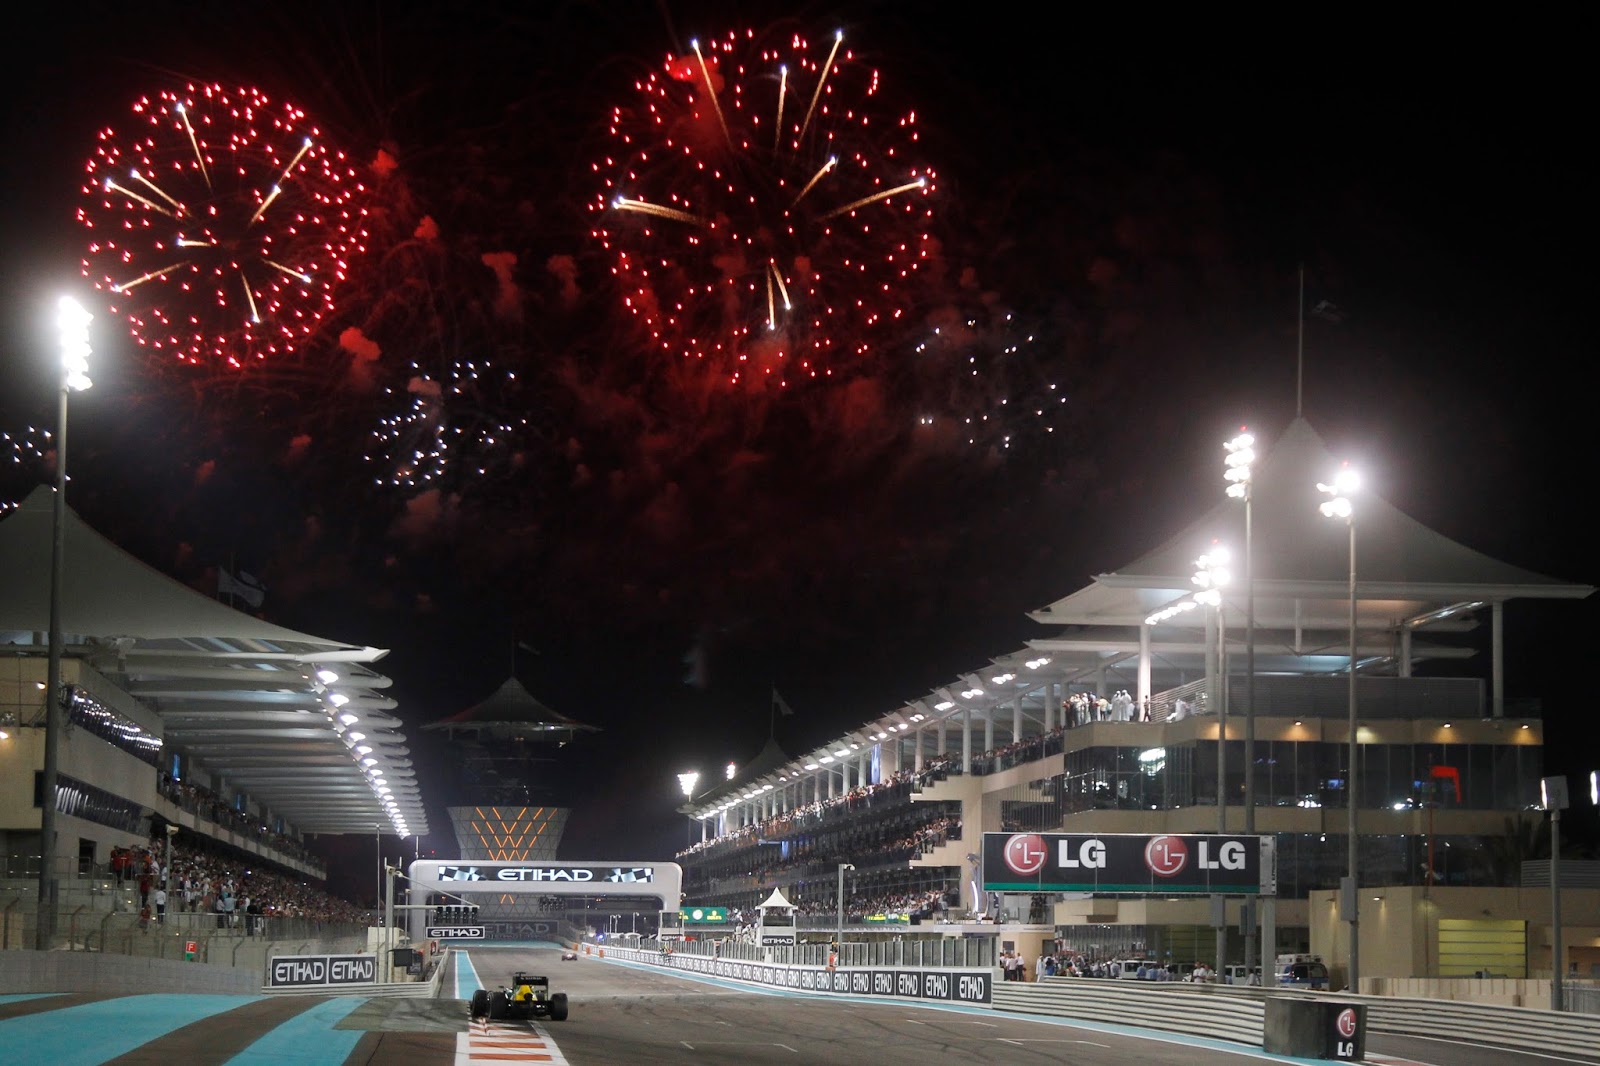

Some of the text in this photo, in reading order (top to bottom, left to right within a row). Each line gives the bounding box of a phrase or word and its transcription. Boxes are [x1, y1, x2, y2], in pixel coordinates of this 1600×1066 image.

[1058, 839, 1107, 869] LG
[1198, 841, 1247, 870] LG
[497, 868, 594, 882] ETIHAD
[430, 929, 481, 938] ETIHAD
[762, 937, 794, 945] ETIHAD
[275, 962, 325, 982] ETIHAD
[331, 960, 373, 980] ETIHAD
[853, 973, 869, 992] ETIHAD
[875, 973, 892, 993] ETIHAD
[898, 974, 918, 996] ETIHAD
[926, 974, 948, 997] ETIHAD
[959, 976, 984, 1000] ETIHAD
[1337, 1041, 1354, 1057] LG
